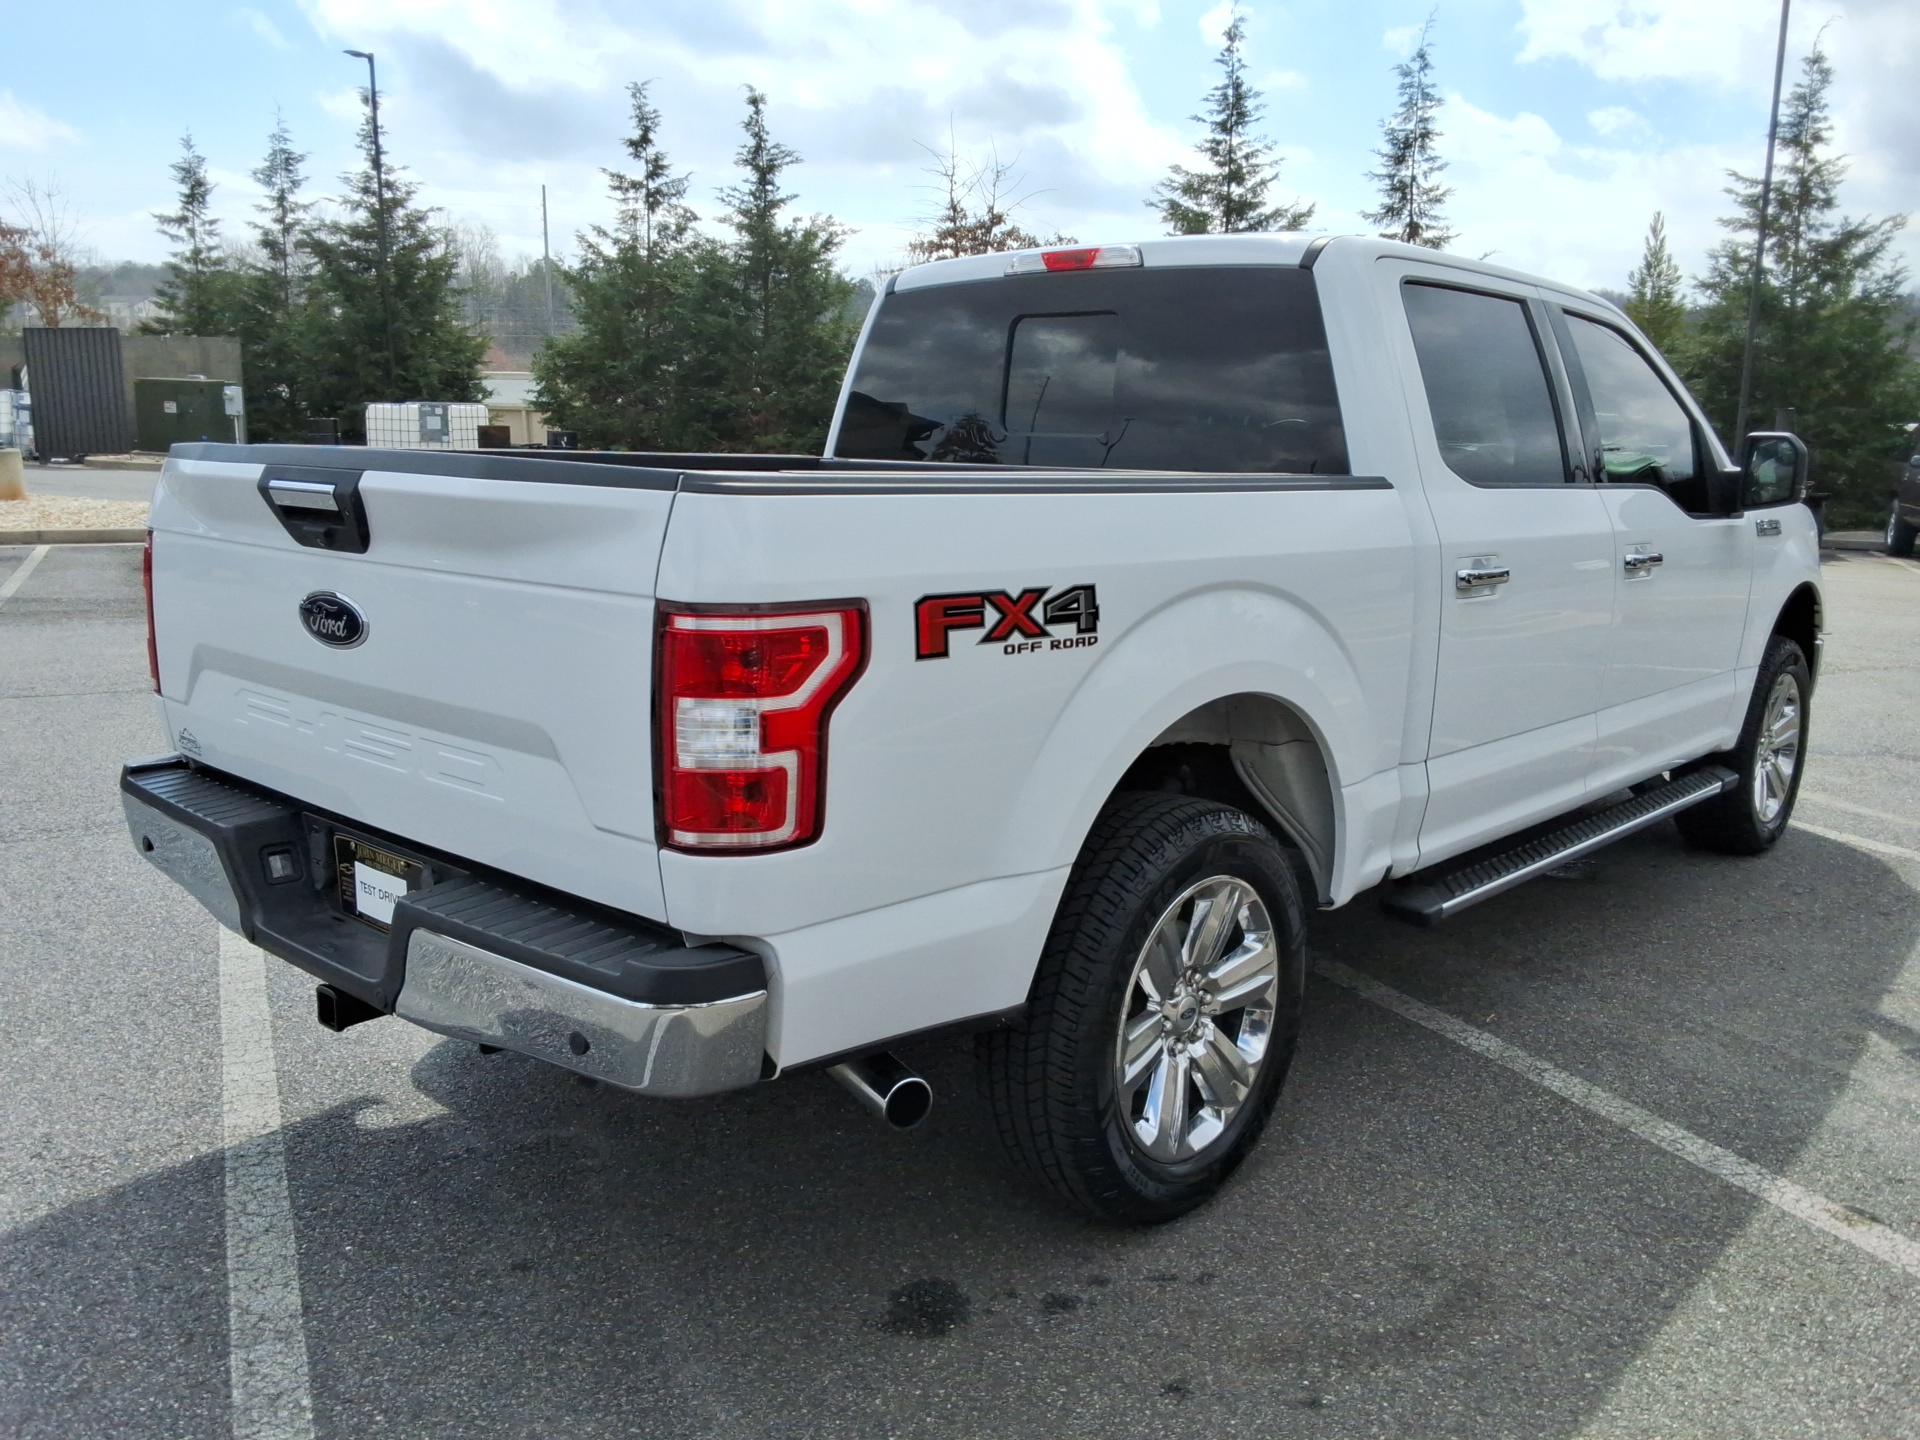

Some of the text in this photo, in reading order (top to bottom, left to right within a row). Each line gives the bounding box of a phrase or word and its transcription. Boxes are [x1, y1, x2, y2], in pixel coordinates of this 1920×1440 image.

[309, 601, 348, 637] Ford
[913, 583, 1099, 662] FX4
[1003, 635, 1098, 655] OFF ROAD
[359, 880, 377, 897] TEST
[378, 888, 400, 905] DRIV
